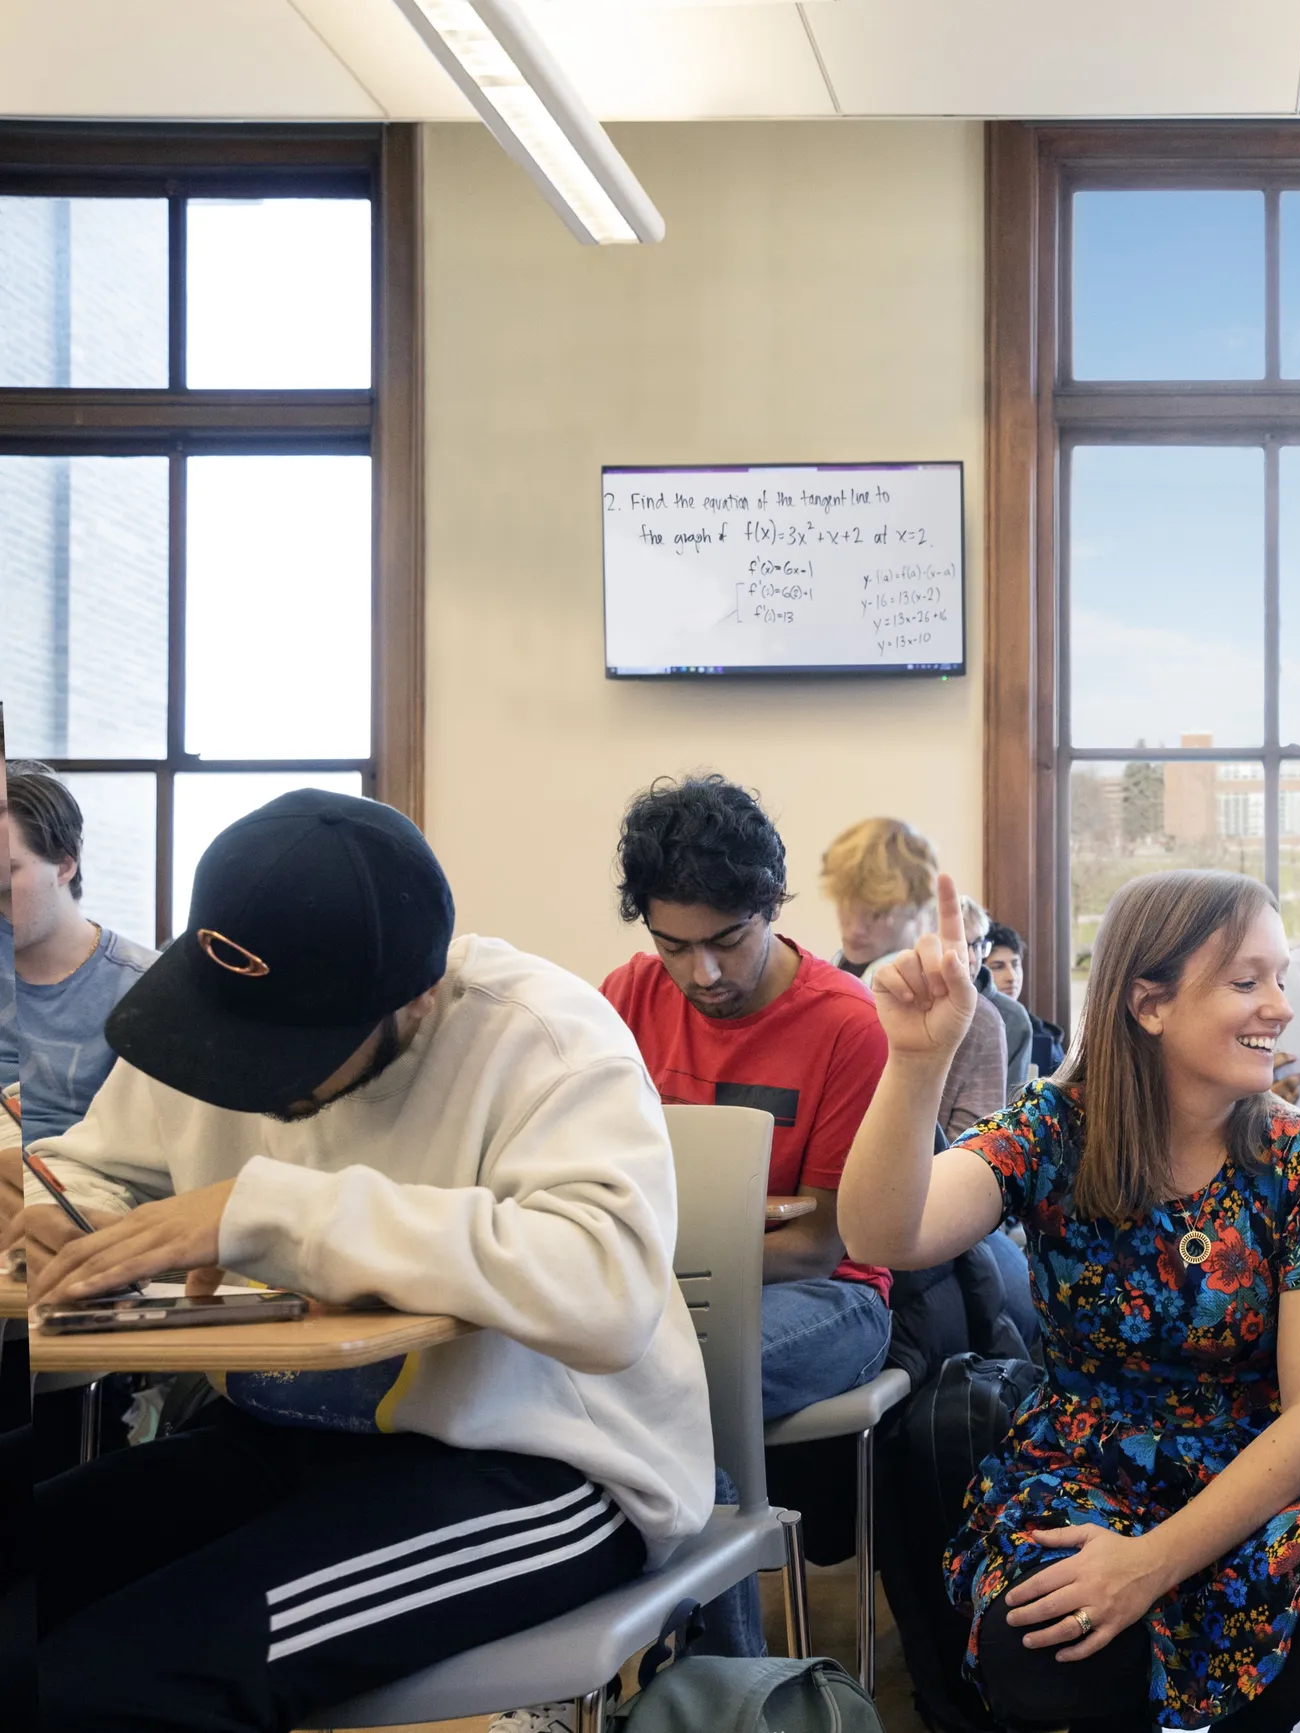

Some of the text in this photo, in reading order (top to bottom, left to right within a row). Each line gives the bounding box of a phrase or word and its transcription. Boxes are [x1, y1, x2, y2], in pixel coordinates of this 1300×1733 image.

[604, 485, 890, 514] 2. Find the equation of the tangent line to
[639, 524, 662, 545] the
[674, 528, 712, 556] graph
[874, 524, 888, 545] at
